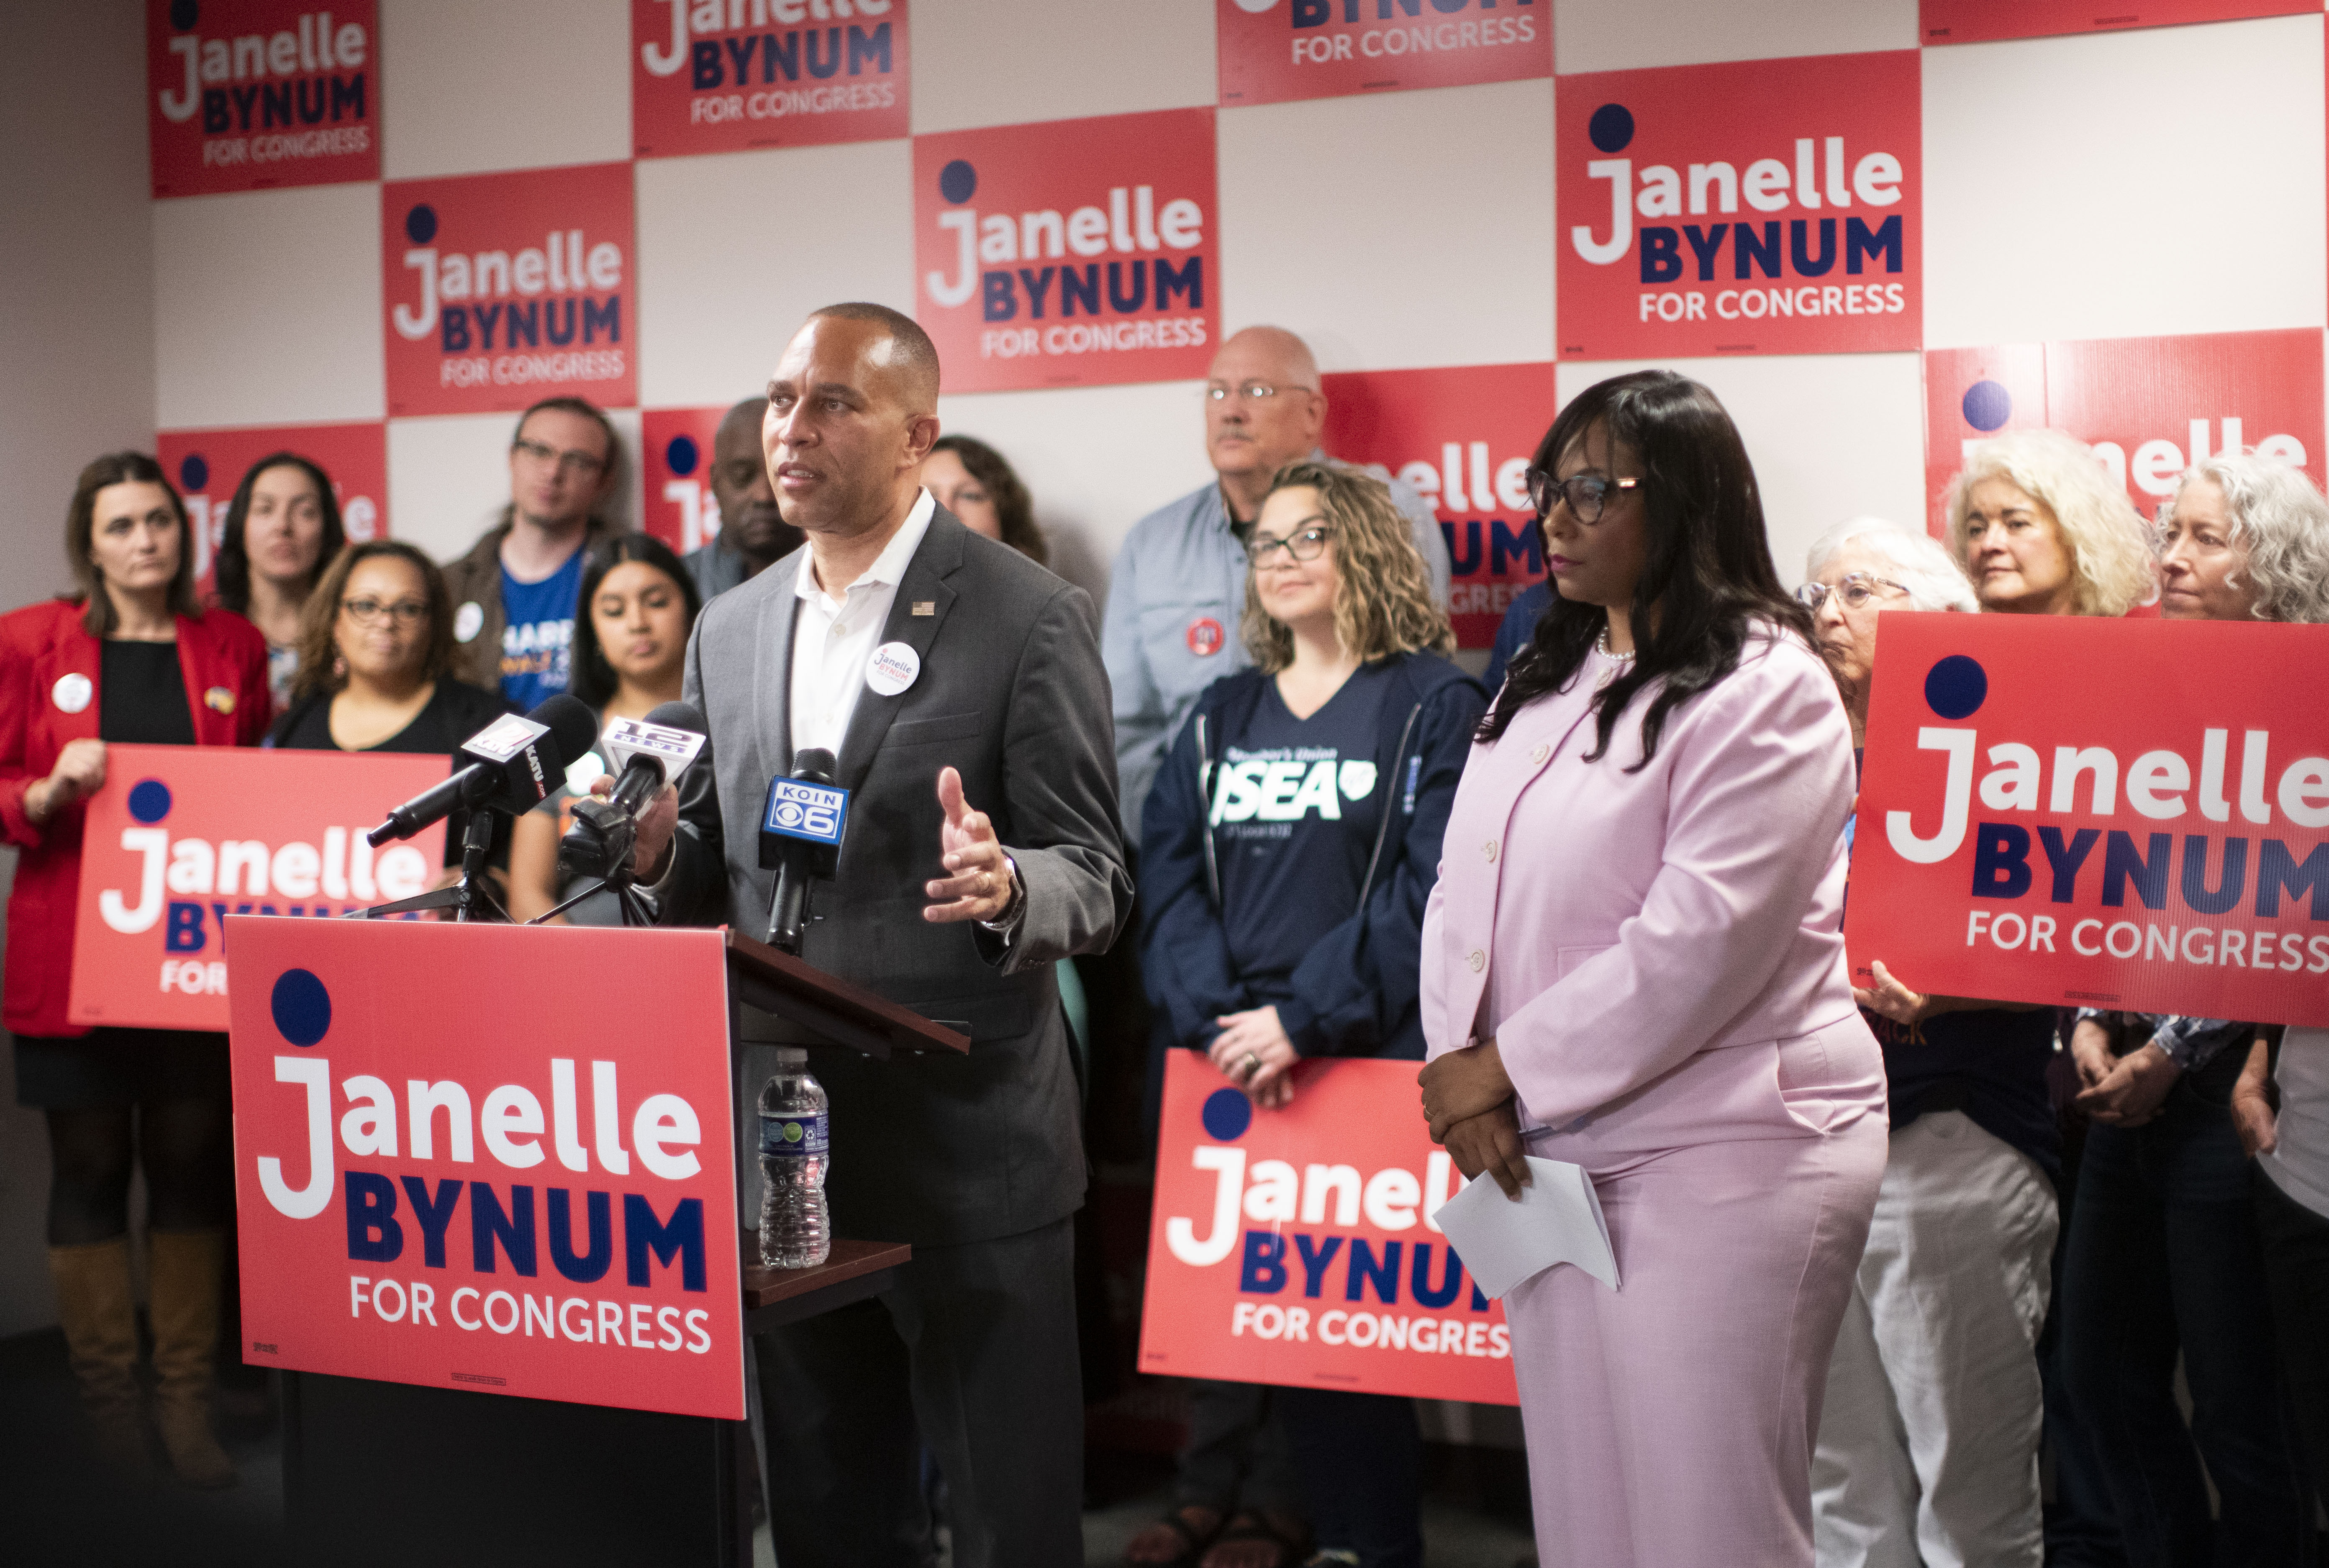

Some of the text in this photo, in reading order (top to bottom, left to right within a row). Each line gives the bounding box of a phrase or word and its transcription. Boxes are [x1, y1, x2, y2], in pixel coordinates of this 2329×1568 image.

[694, 22, 892, 90] BYNUM
[1291, 15, 1536, 65] FOR CONGRESS
[204, 73, 364, 134] BYNUM
[691, 82, 895, 124] FOR CONGRESS
[1639, 214, 1904, 284] BYNUM
[983, 256, 1203, 323] BYNUM
[1639, 283, 1905, 323] FOR CONGRESS
[441, 295, 622, 354] BYNUM
[982, 317, 1208, 359] FOR CONGRESS
[440, 349, 625, 389] FOR CONGRESS
[879, 663, 909, 681] BYNUM
[617, 721, 693, 747] 12
[620, 735, 680, 753] NEWS
[783, 787, 836, 806] KOIN
[804, 806, 834, 834] 6
[1972, 822, 2329, 921] BYNUM
[1967, 910, 2329, 974] FOR CONGRESS
[1166, 1088, 1471, 1267] janel
[344, 1171, 707, 1293] BYNUM
[1239, 1229, 1490, 1313] BYNU
[350, 1275, 712, 1355] FOR CONGRESS
[1232, 1302, 1512, 1360] FOR CONGRES
